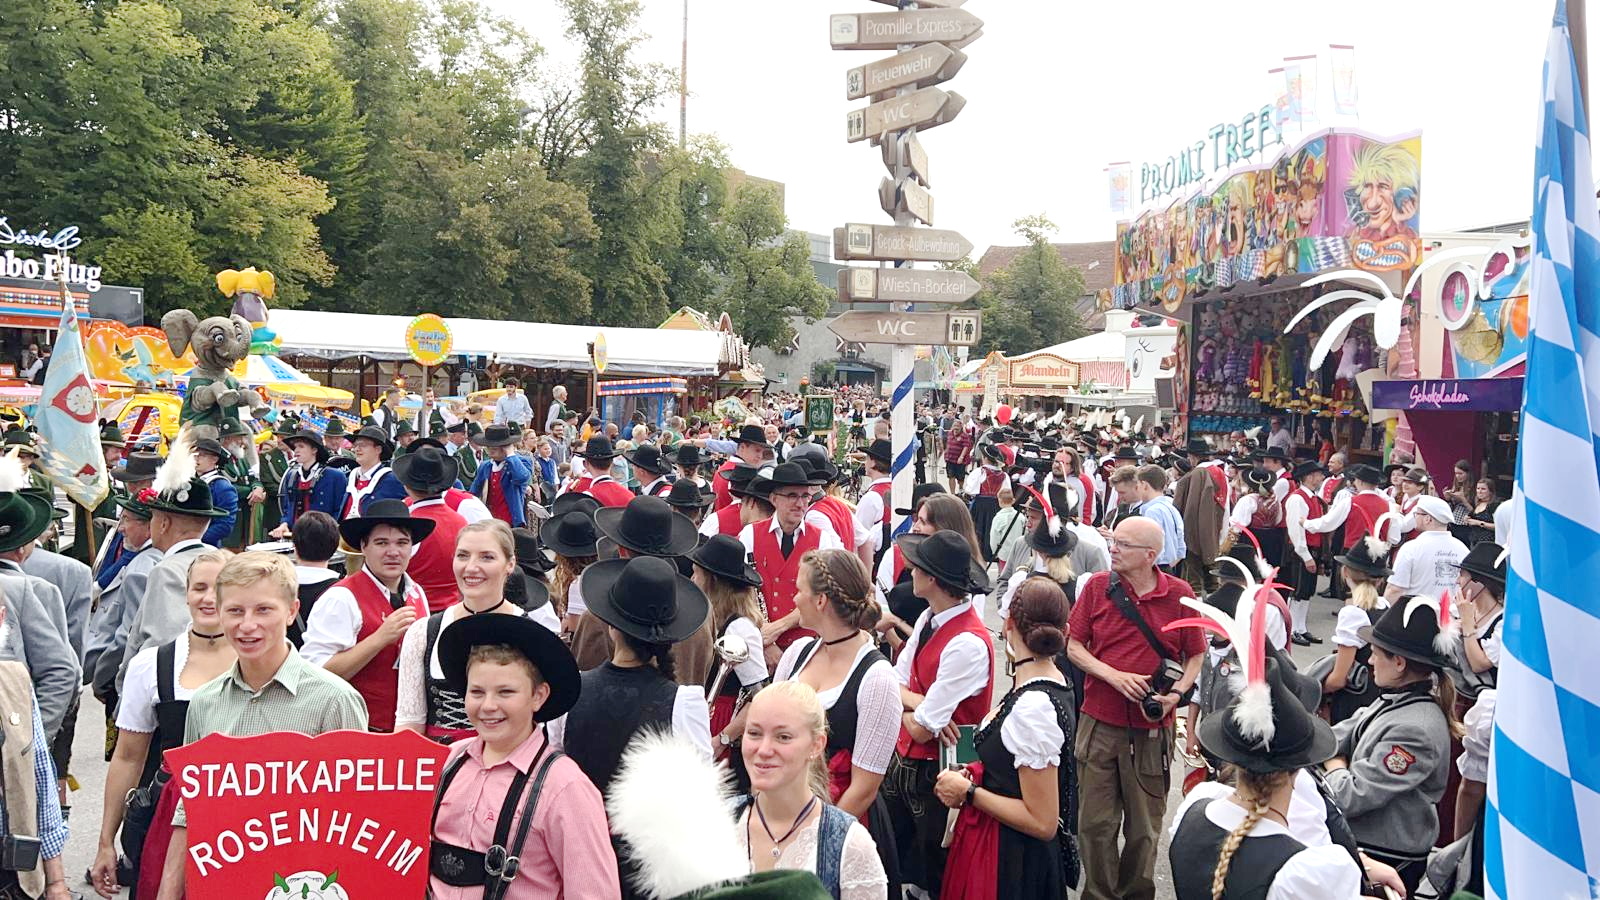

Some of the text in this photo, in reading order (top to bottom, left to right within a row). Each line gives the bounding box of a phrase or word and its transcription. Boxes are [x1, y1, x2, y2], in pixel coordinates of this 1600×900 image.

[866, 18, 962, 37] Promille Express
[871, 55, 934, 84] Feuerwehr
[883, 102, 912, 124] WC
[1140, 103, 1283, 204] PROMI TREF
[42, 252, 102, 292] Flug
[876, 319, 917, 336] WC
[1020, 363, 1071, 378] Mandeln
[1409, 380, 1470, 409] Schokoladen
[180, 757, 436, 800] STADTKAPELLE
[188, 807, 424, 877] ROSENHEIM
